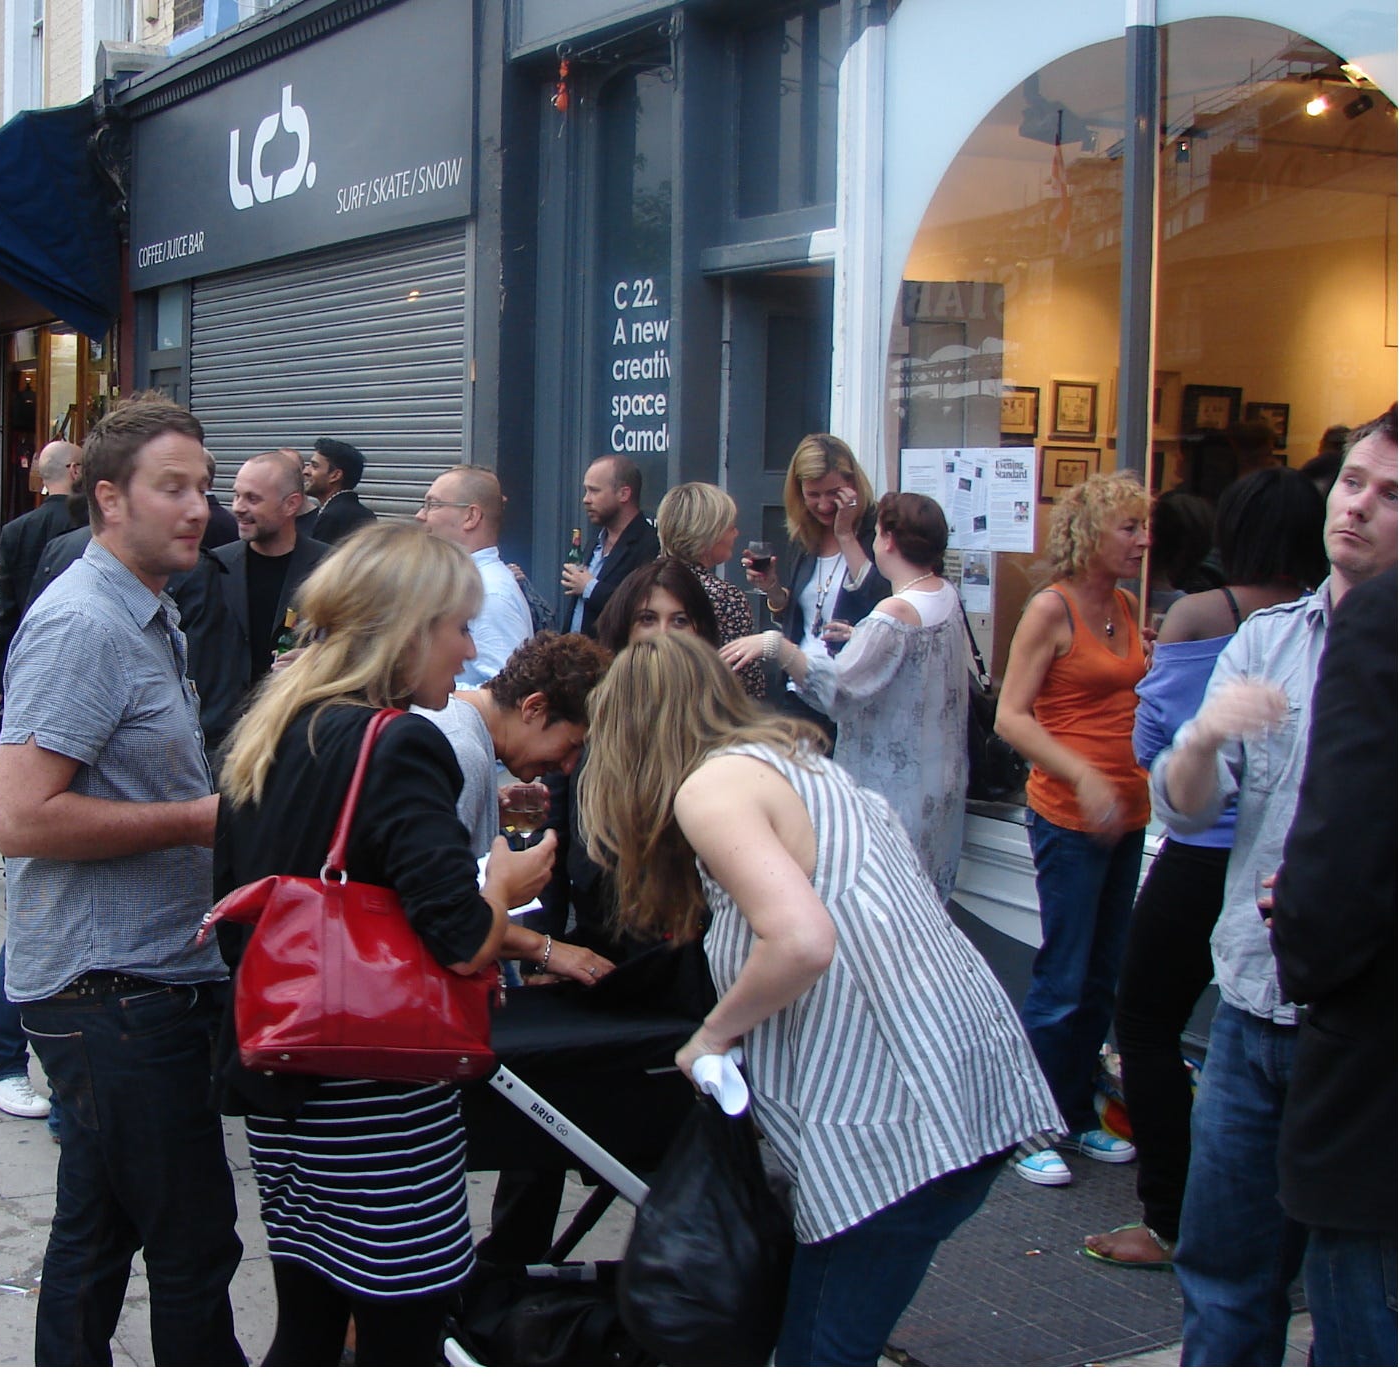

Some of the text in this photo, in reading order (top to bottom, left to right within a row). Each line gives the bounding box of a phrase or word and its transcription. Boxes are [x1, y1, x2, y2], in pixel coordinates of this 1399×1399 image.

[188, 230, 206, 257] BAR
[613, 278, 658, 310] C 22.
[612, 317, 670, 346] A new
[612, 349, 671, 381] creativ
[611, 393, 667, 423] space
[610, 423, 670, 452] Camd
[530, 1102, 555, 1124] BRIO
